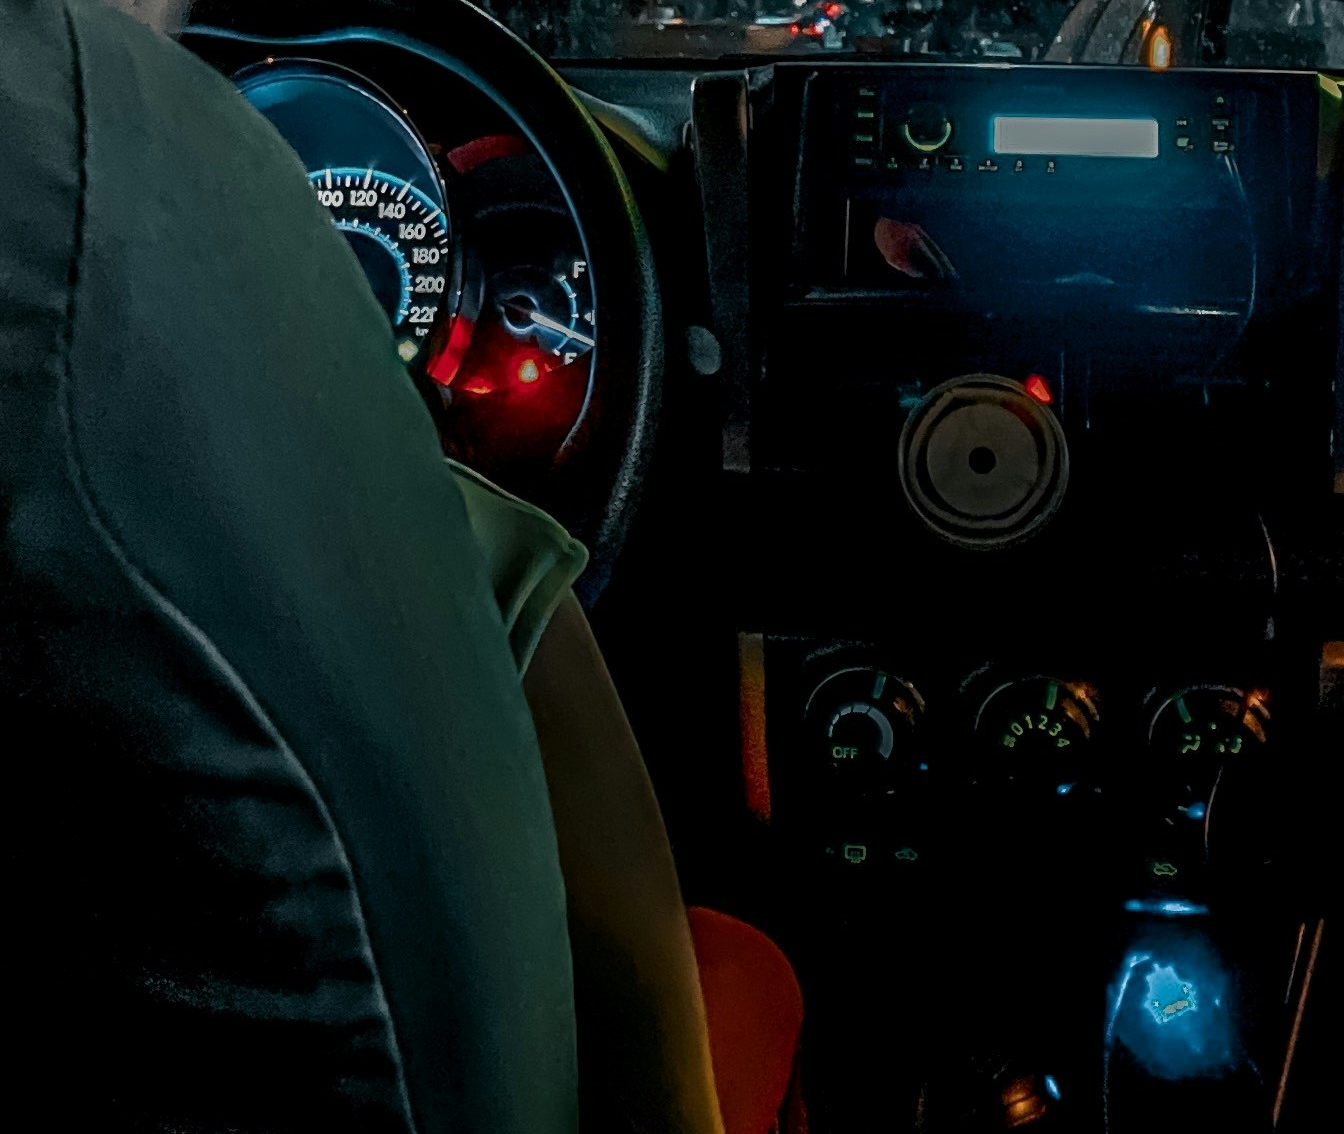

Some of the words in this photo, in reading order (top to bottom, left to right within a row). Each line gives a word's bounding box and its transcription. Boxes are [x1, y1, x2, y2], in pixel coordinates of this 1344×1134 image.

[350, 190, 378, 206] 120
[378, 202, 406, 219] 140
[398, 223, 427, 240] 160
[412, 247, 440, 264] 180
[573, 261, 587, 279] F
[415, 276, 445, 294] 200
[1038, 715, 1048, 730] 2
[1048, 722, 1062, 737] 3
[832, 746, 858, 759] OFF
